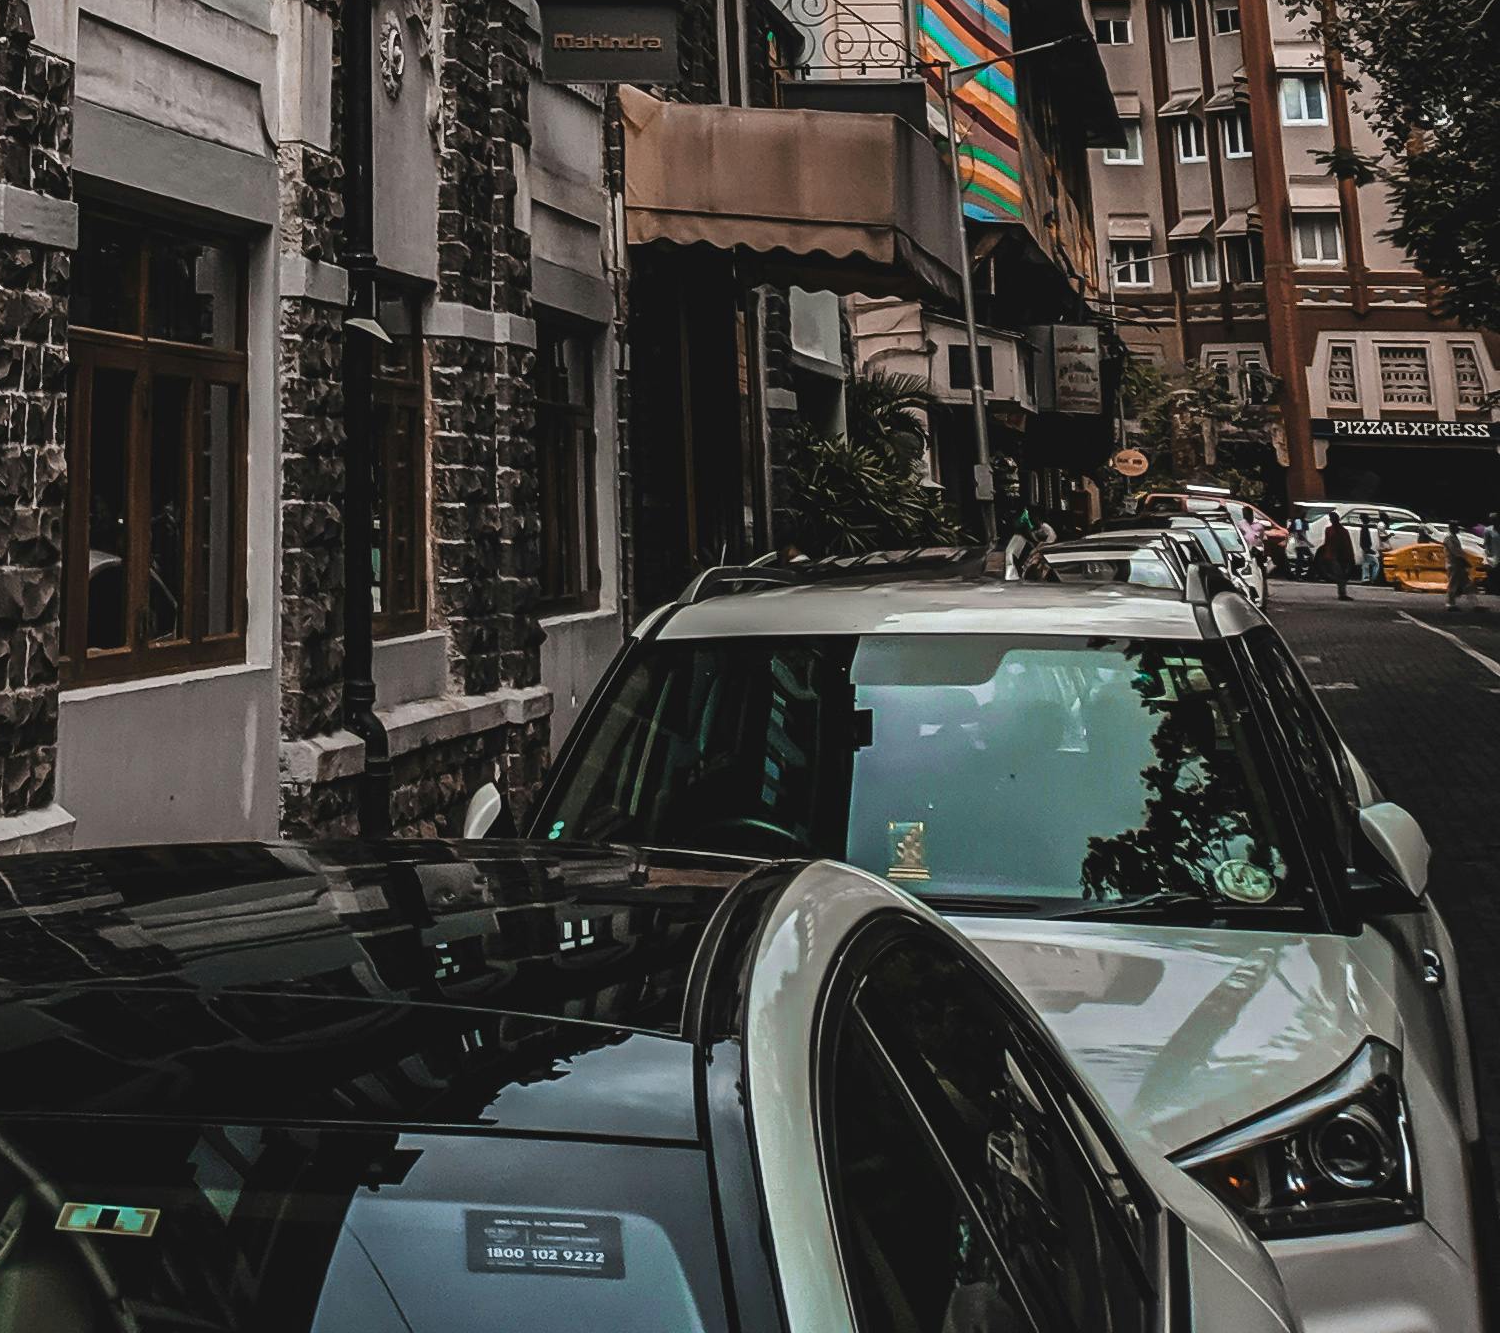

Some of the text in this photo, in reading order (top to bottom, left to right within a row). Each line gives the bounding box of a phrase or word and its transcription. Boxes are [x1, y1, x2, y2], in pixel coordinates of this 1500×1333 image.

[1333, 420, 1491, 438] PIZZAEXPRESS
[486, 1247, 605, 1263] 1800 102 9222
